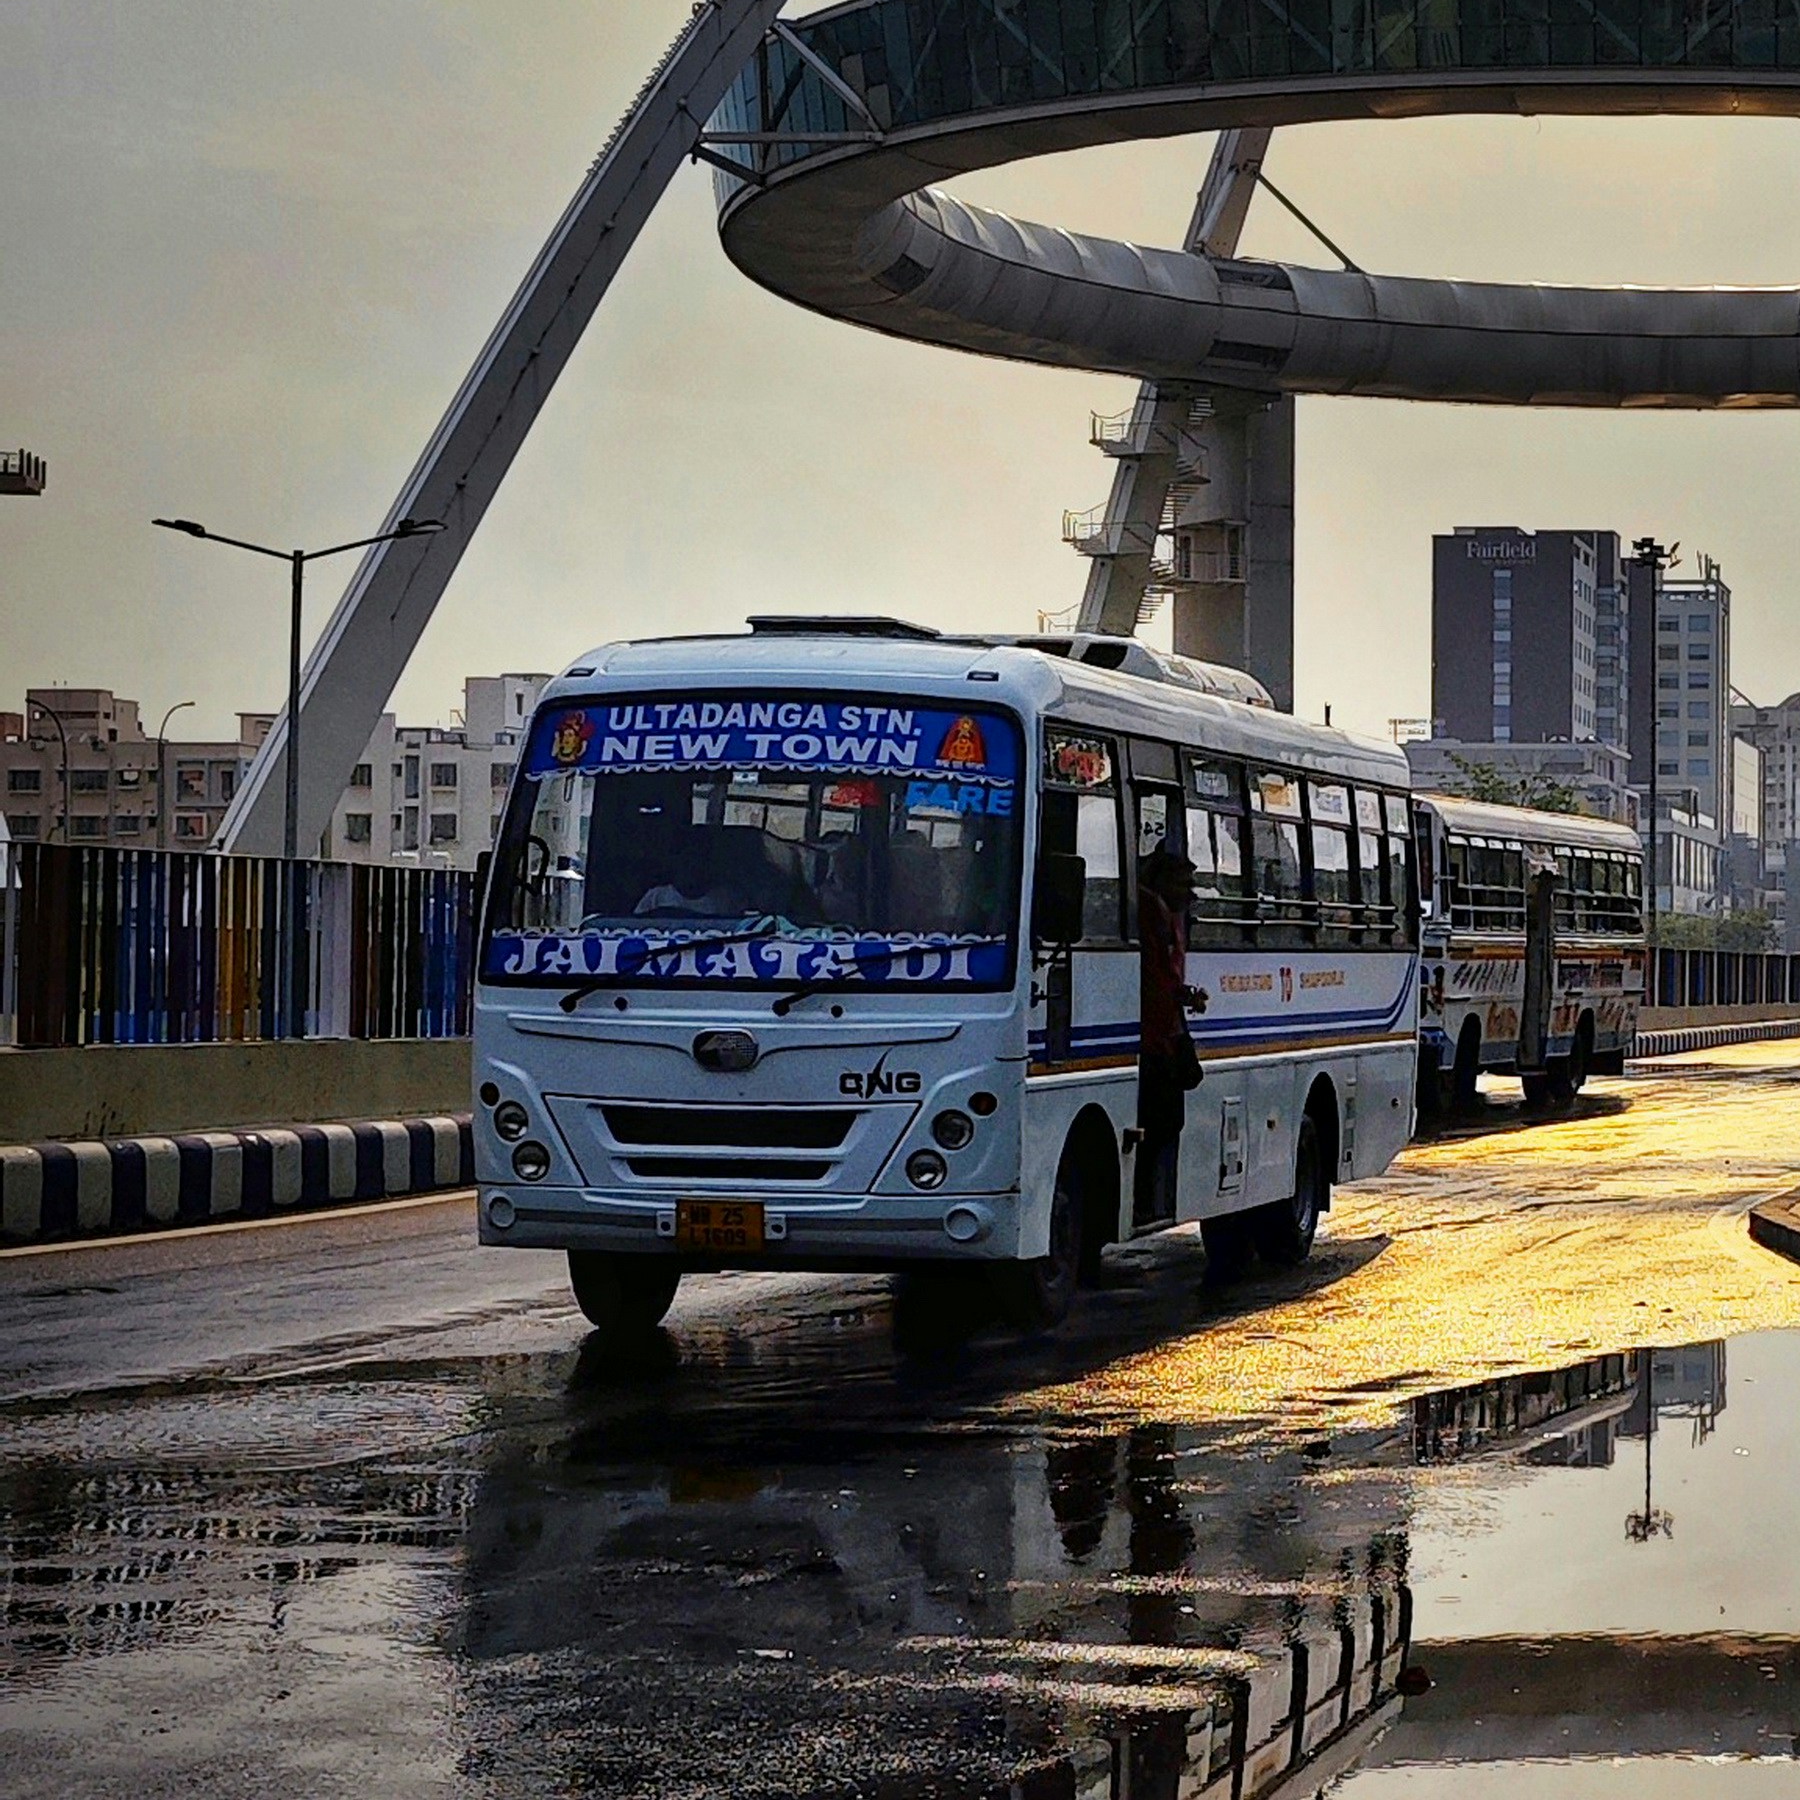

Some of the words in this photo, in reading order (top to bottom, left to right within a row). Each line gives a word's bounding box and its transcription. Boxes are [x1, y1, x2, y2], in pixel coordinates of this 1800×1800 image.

[1465, 540, 1537, 558] Fairfield
[608, 703, 827, 731] ULTADANGA
[839, 706, 922, 736] STN.
[601, 734, 730, 761] NEW
[745, 734, 918, 766] TOWN
[905, 782, 1014, 816] FARE
[503, 938, 625, 974] JAI
[636, 939, 867, 980] MATA
[885, 943, 975, 981] DI
[838, 1060, 922, 1099] CNG
